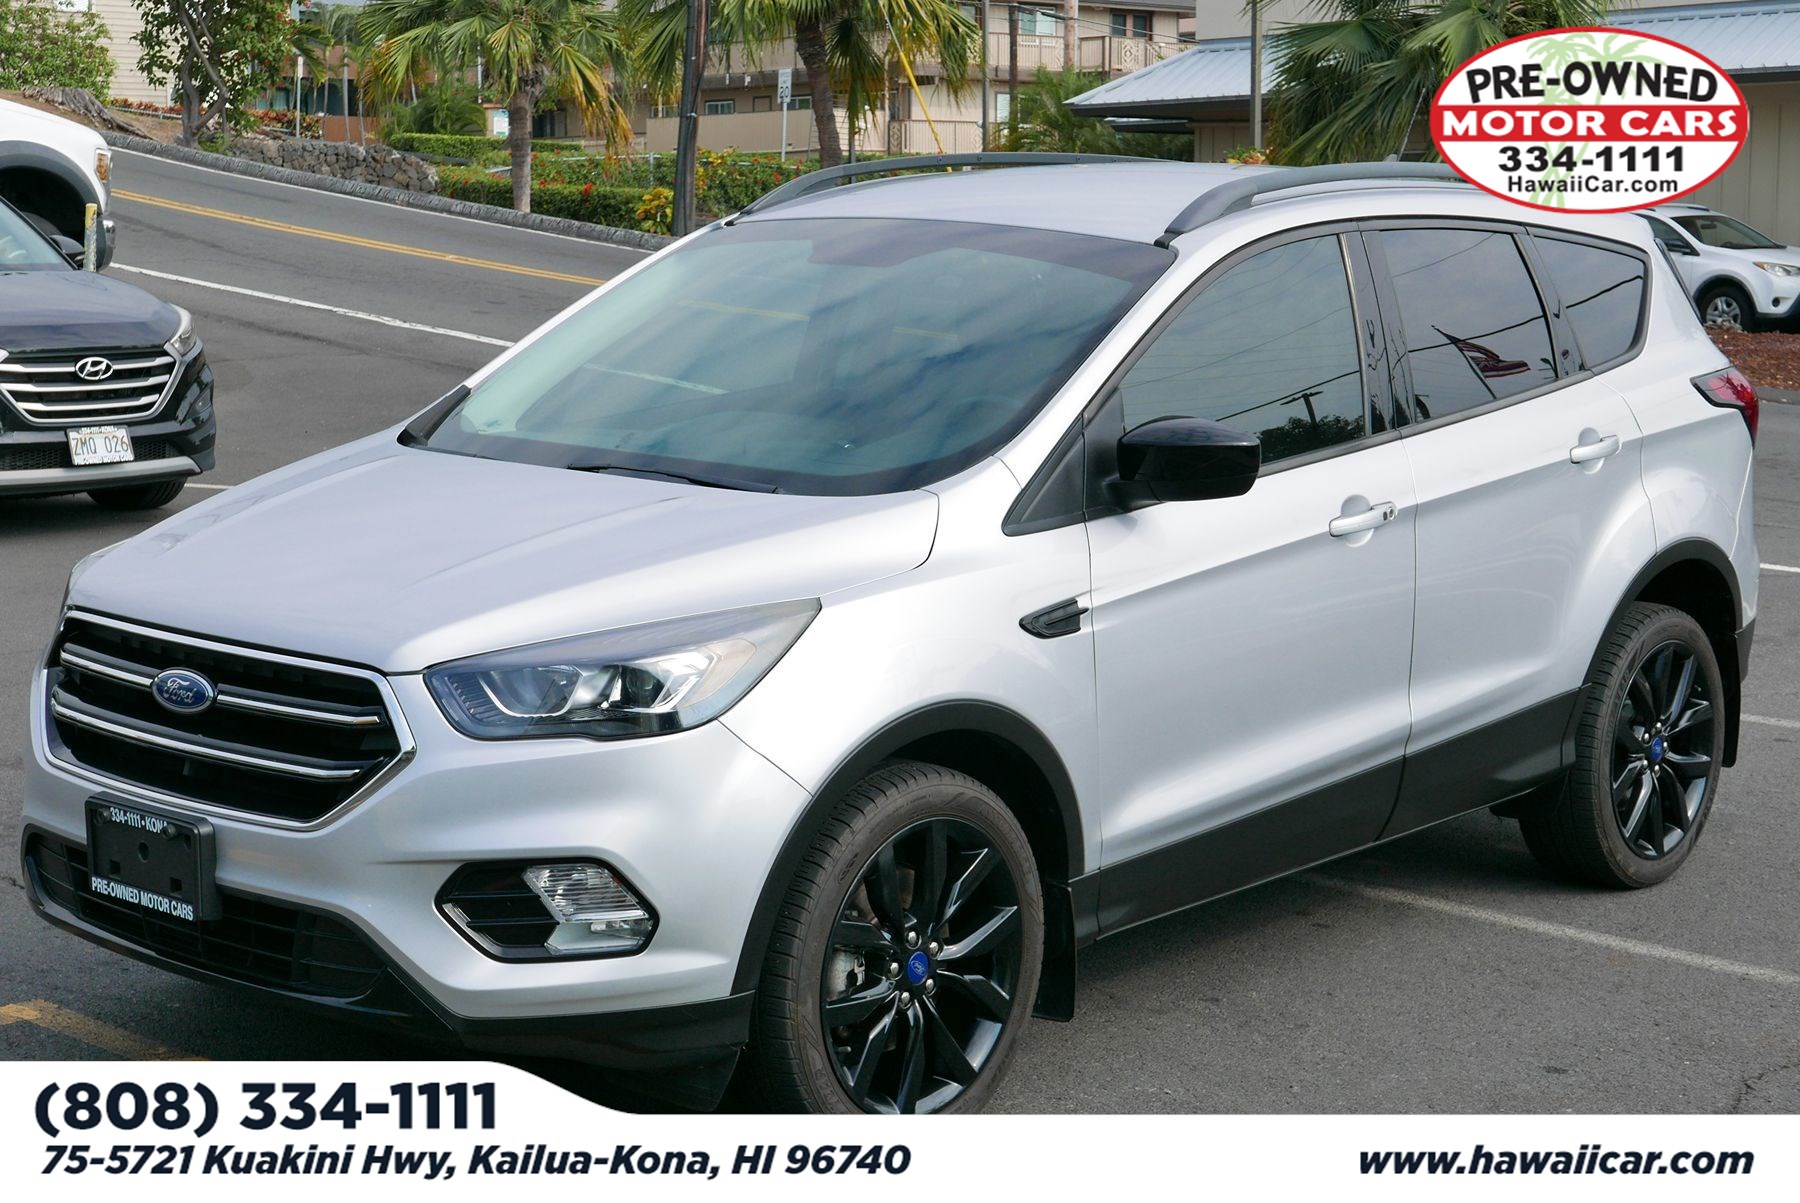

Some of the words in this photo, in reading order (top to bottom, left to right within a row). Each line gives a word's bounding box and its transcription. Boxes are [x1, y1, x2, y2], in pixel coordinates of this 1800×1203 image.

[72, 436, 97, 456] ZMQ
[104, 434, 129, 454] 026
[163, 677, 197, 703] Ford
[110, 806, 141, 828] 334-1111
[91, 877, 139, 904] PRE-OWNED
[140, 892, 170, 914] MOTOR
[171, 900, 194, 921] CARS
